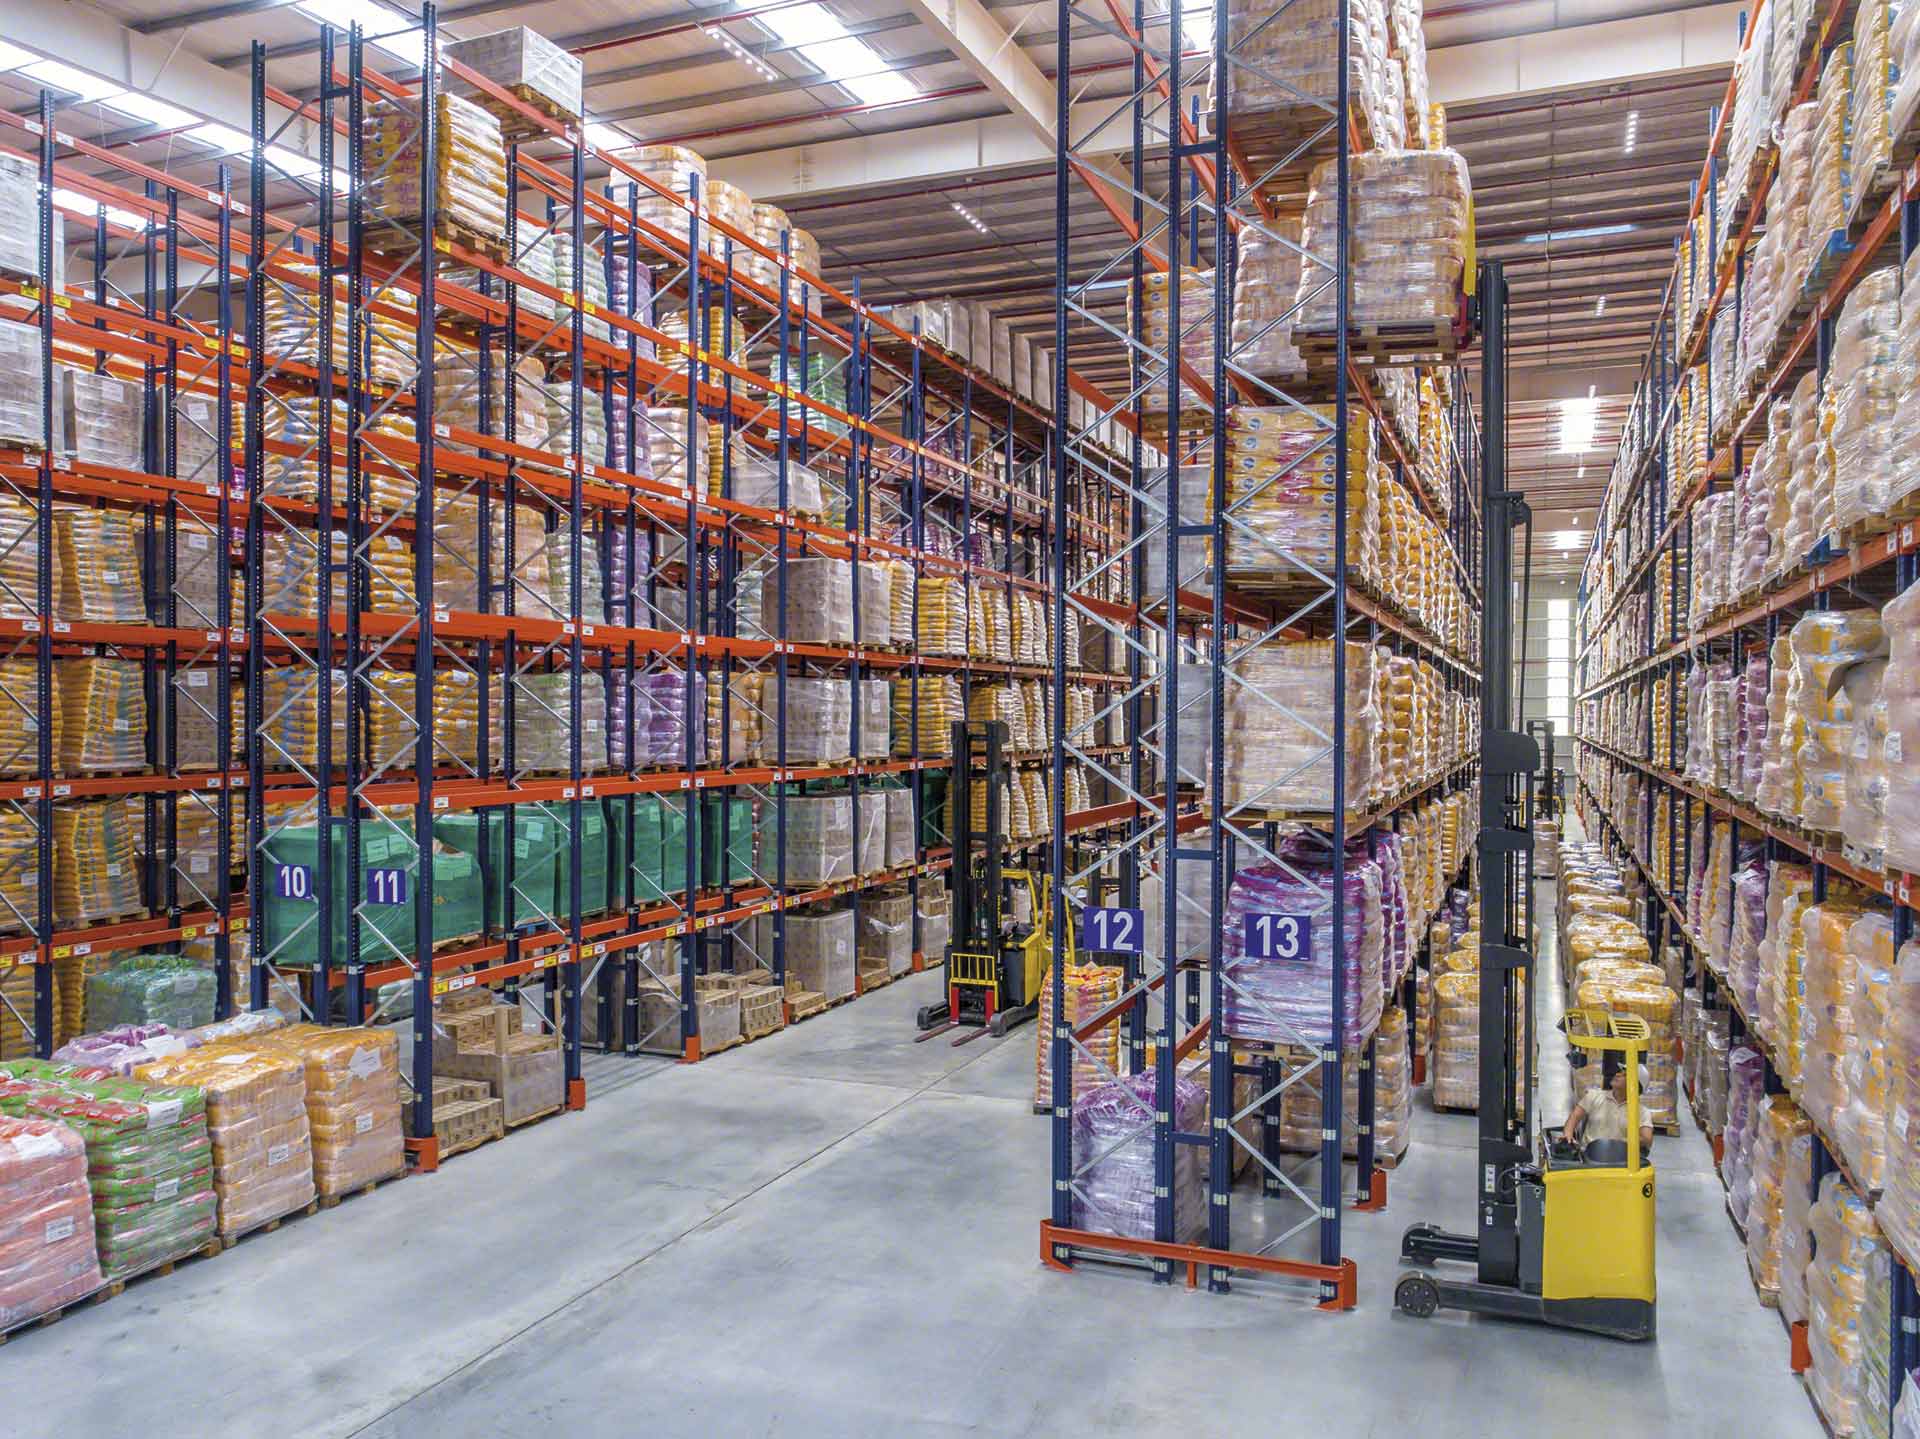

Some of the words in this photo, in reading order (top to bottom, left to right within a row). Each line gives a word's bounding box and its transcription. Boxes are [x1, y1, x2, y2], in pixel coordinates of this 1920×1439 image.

[281, 866, 306, 897] 10
[374, 870, 398, 902] 11
[1093, 910, 1133, 950] 12
[1256, 916, 1299, 957] 13
